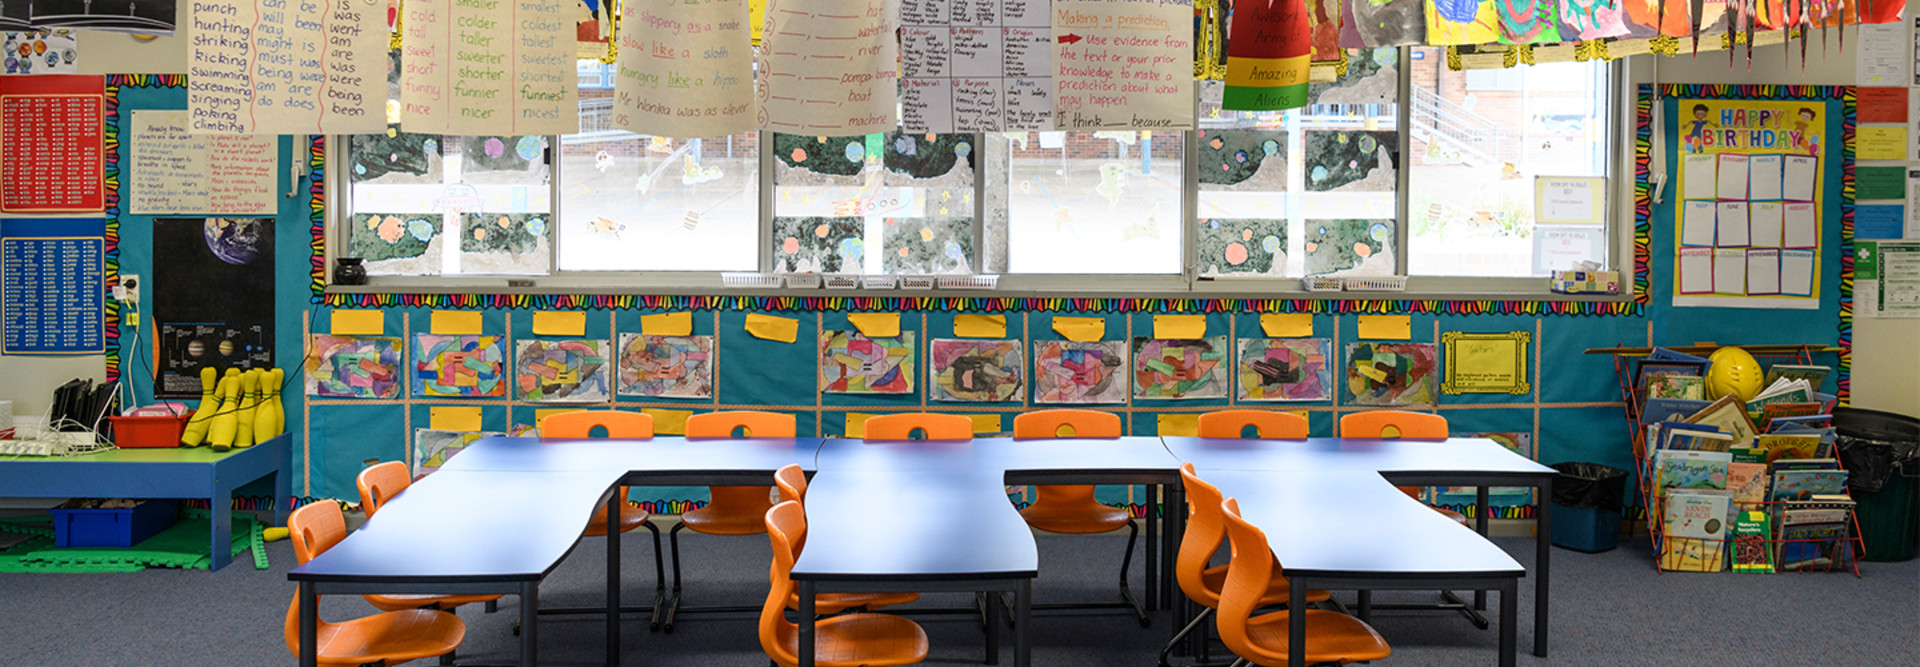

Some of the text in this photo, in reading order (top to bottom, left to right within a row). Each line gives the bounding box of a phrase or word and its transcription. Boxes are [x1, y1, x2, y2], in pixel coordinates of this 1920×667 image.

[193, 2, 237, 15] punch
[263, 0, 317, 13] can be
[337, 0, 350, 10] is
[456, 0, 561, 13] smaller smallest
[263, 12, 322, 31] will been
[334, 11, 361, 21] was
[411, 10, 562, 31] cold colder coldest
[625, 7, 634, 17] as
[641, 10, 680, 35] slippery
[687, 23, 701, 32] as
[1057, 9, 1098, 29] Making
[1118, 14, 1168, 28] prediction
[194, 16, 250, 36] hunting
[259, 24, 284, 39] may
[330, 23, 362, 36] went
[765, 16, 776, 36] 2)
[257, 36, 315, 53] might is
[331, 37, 351, 47] am
[409, 24, 556, 48] tall taller tallest
[1087, 35, 1188, 47] Use evidence from
[1254, 29, 1287, 49] Army
[194, 35, 248, 55] striking
[406, 43, 568, 64] sweet sweeter sweetest
[623, 35, 728, 59] slow like a sloth
[761, 39, 882, 56] 3) river
[195, 49, 247, 72] kicking
[259, 52, 320, 68] must was
[332, 50, 353, 60] are
[1060, 47, 1076, 60] the
[1084, 49, 1107, 62] text
[1127, 56, 1148, 68] your
[1153, 56, 1176, 66] prior
[258, 66, 325, 84] being were
[331, 63, 355, 72] was
[407, 61, 567, 82] short shorter shortest
[621, 62, 658, 88] hungry
[668, 71, 690, 87] like
[695, 77, 703, 86] a
[760, 60, 770, 78] 4)
[1060, 62, 1113, 83] knowledge
[1121, 67, 1129, 79] to
[1135, 71, 1160, 81] make
[1249, 66, 1297, 83] Amazing
[191, 67, 250, 86] swimming
[330, 76, 362, 86] were
[190, 81, 252, 102] screaming
[256, 83, 312, 96] am are
[406, 79, 567, 100] funny funnier funniest
[759, 80, 872, 102] 5) boat
[1059, 80, 1178, 94] prediction about what
[191, 95, 240, 110] singing
[258, 94, 314, 110] do does
[328, 87, 362, 105] being
[619, 91, 632, 106] Mr
[677, 106, 700, 117] was
[704, 106, 717, 116] as
[723, 103, 749, 115] clever
[1060, 93, 1127, 110] may happen
[1255, 93, 1290, 107] Aliens
[193, 108, 237, 121] poking
[332, 103, 364, 116] been
[407, 103, 559, 119] nice nicer nicest
[758, 106, 886, 128] 6) machine
[1720, 108, 1784, 127] HAPPY
[194, 120, 244, 133] climbing
[616, 114, 629, 126] as
[1058, 111, 1066, 127] I
[1073, 113, 1102, 127] think
[1132, 114, 1171, 127] because
[1702, 129, 1801, 148] BIRTHDAY
[1765, 439, 1811, 450] DROUGHT
[1684, 511, 1711, 519] BEACH
